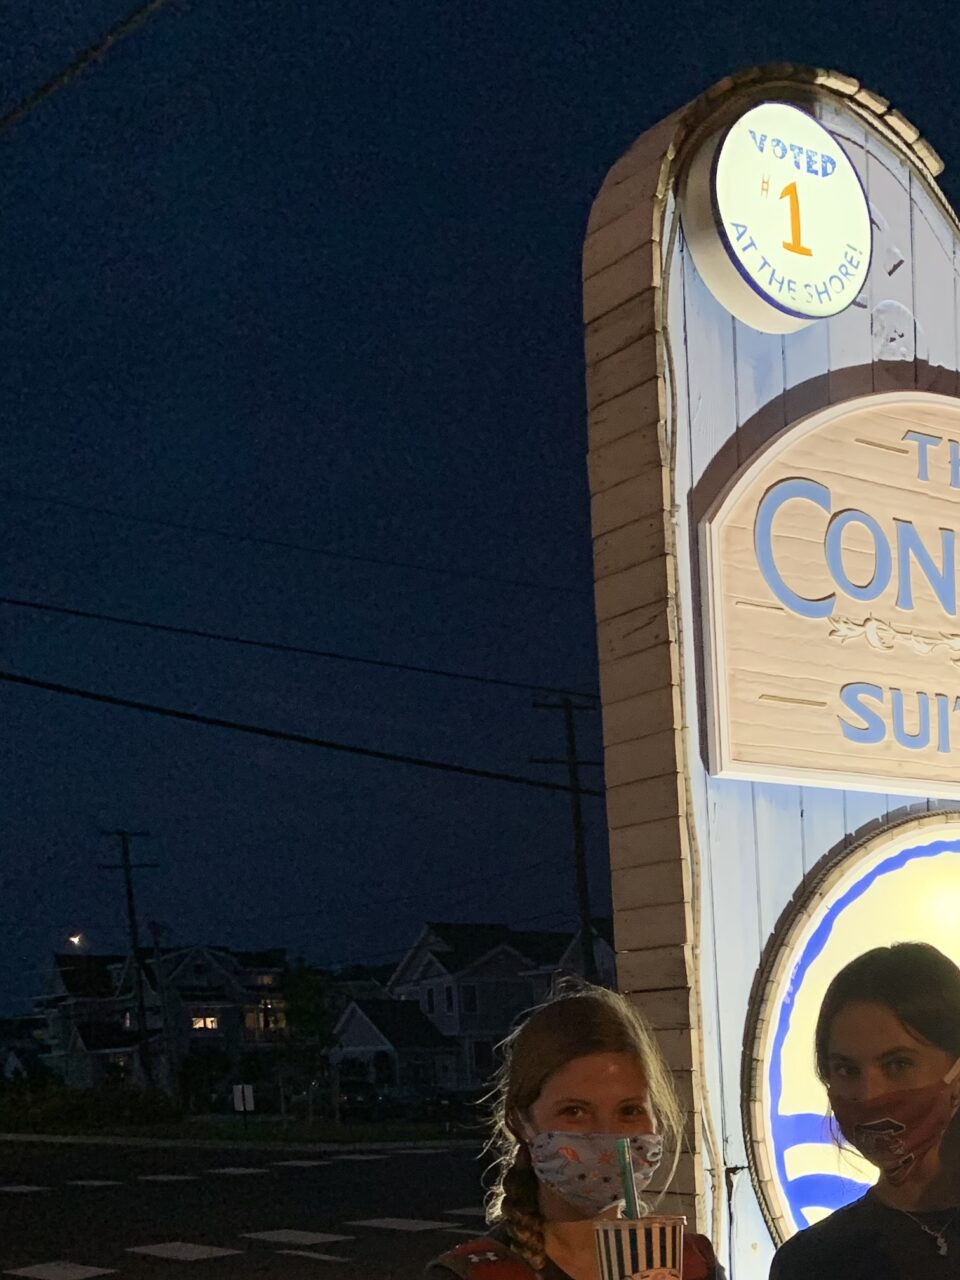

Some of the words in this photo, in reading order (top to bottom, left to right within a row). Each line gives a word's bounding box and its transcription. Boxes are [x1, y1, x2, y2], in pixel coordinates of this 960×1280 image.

[748, 128, 838, 178] VOTED
[730, 221, 758, 253] AT
[758, 255, 797, 301] THE
[804, 243, 863, 305] SHORE!
